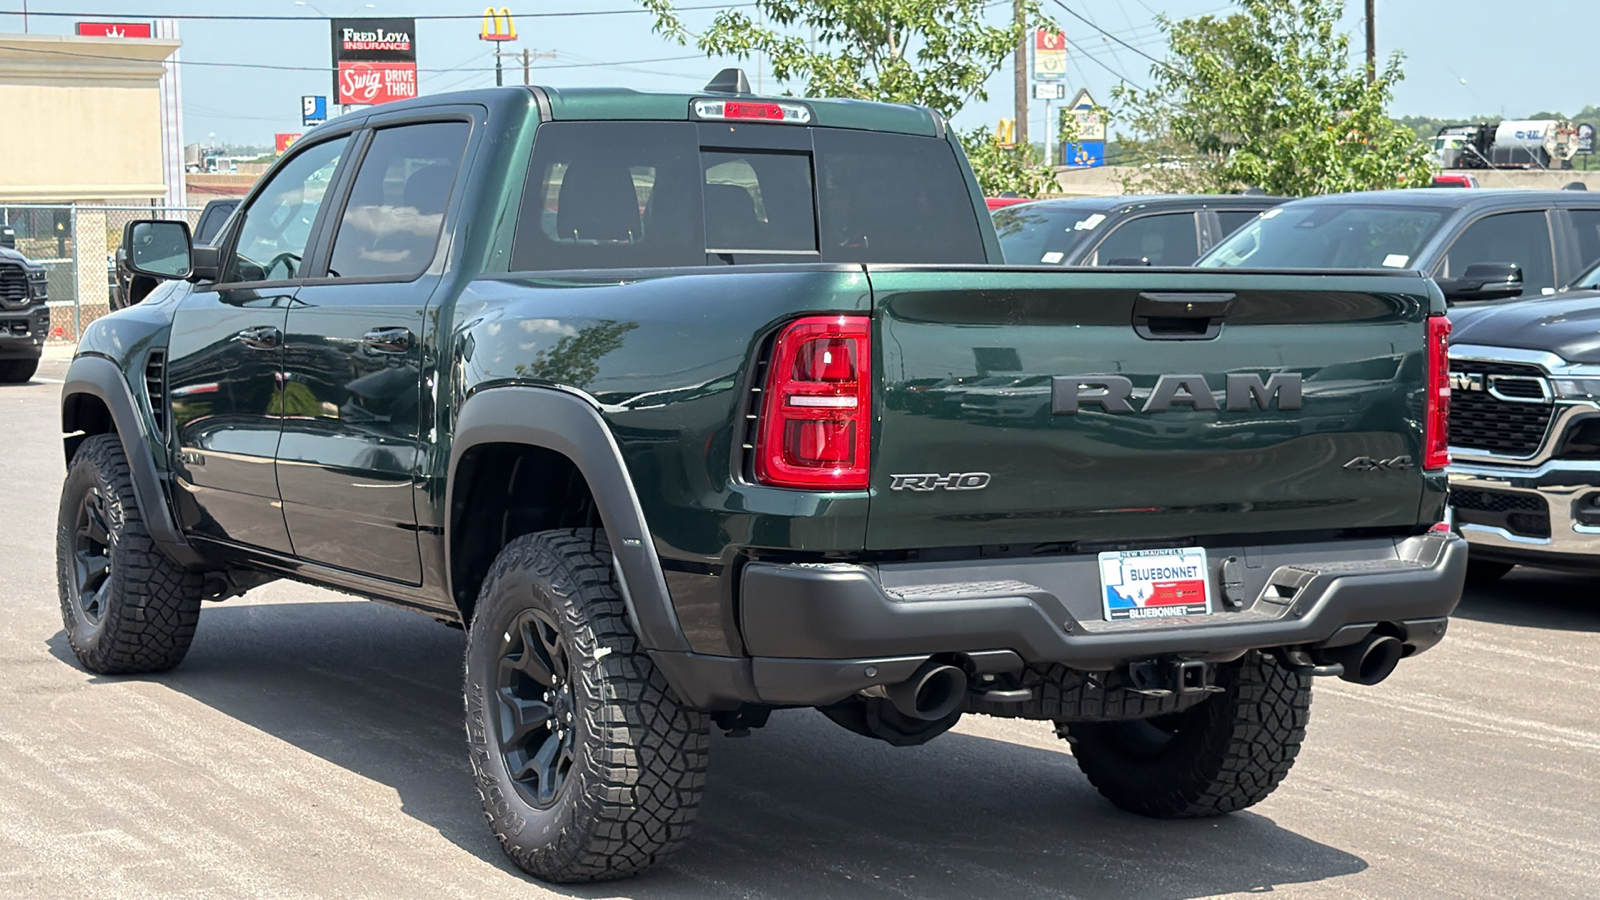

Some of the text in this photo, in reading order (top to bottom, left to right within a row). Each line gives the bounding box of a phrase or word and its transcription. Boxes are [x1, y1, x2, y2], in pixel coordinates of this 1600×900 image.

[343, 28, 410, 43] FRED LOYA
[345, 42, 409, 50] INSURANCE
[385, 69, 414, 82] DRIVE
[341, 69, 383, 98] Swig
[385, 82, 415, 96] THRU
[1051, 373, 1303, 415] RAM
[1343, 454, 1414, 471] 4x4
[889, 472, 992, 492] RHO
[1130, 566, 1197, 581] BLUEBONNET
[1129, 606, 1188, 619] BLUEBONNET
